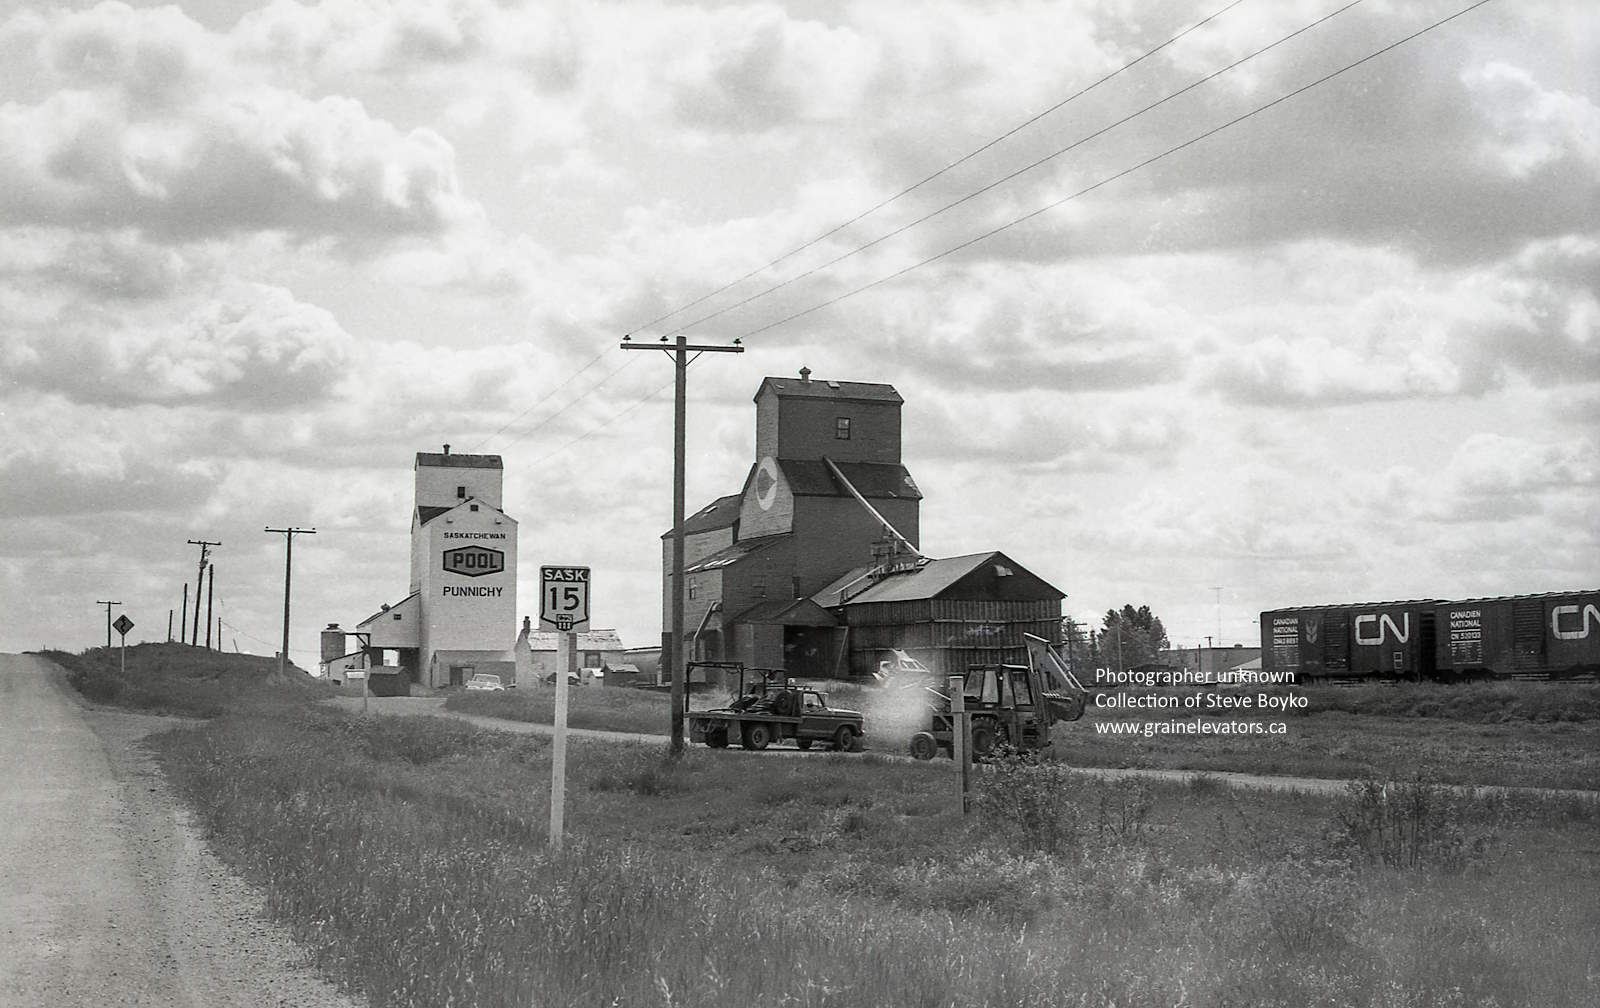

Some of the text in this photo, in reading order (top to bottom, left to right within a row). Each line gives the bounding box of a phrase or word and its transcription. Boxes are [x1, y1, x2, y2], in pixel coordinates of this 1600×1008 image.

[443, 531, 506, 540] SASKATCHEWAN
[453, 552, 498, 569] POOL
[544, 569, 585, 581] SASK
[443, 586, 503, 597] PUNNICHY
[550, 587, 580, 611] 15
[1355, 612, 1409, 646] CN
